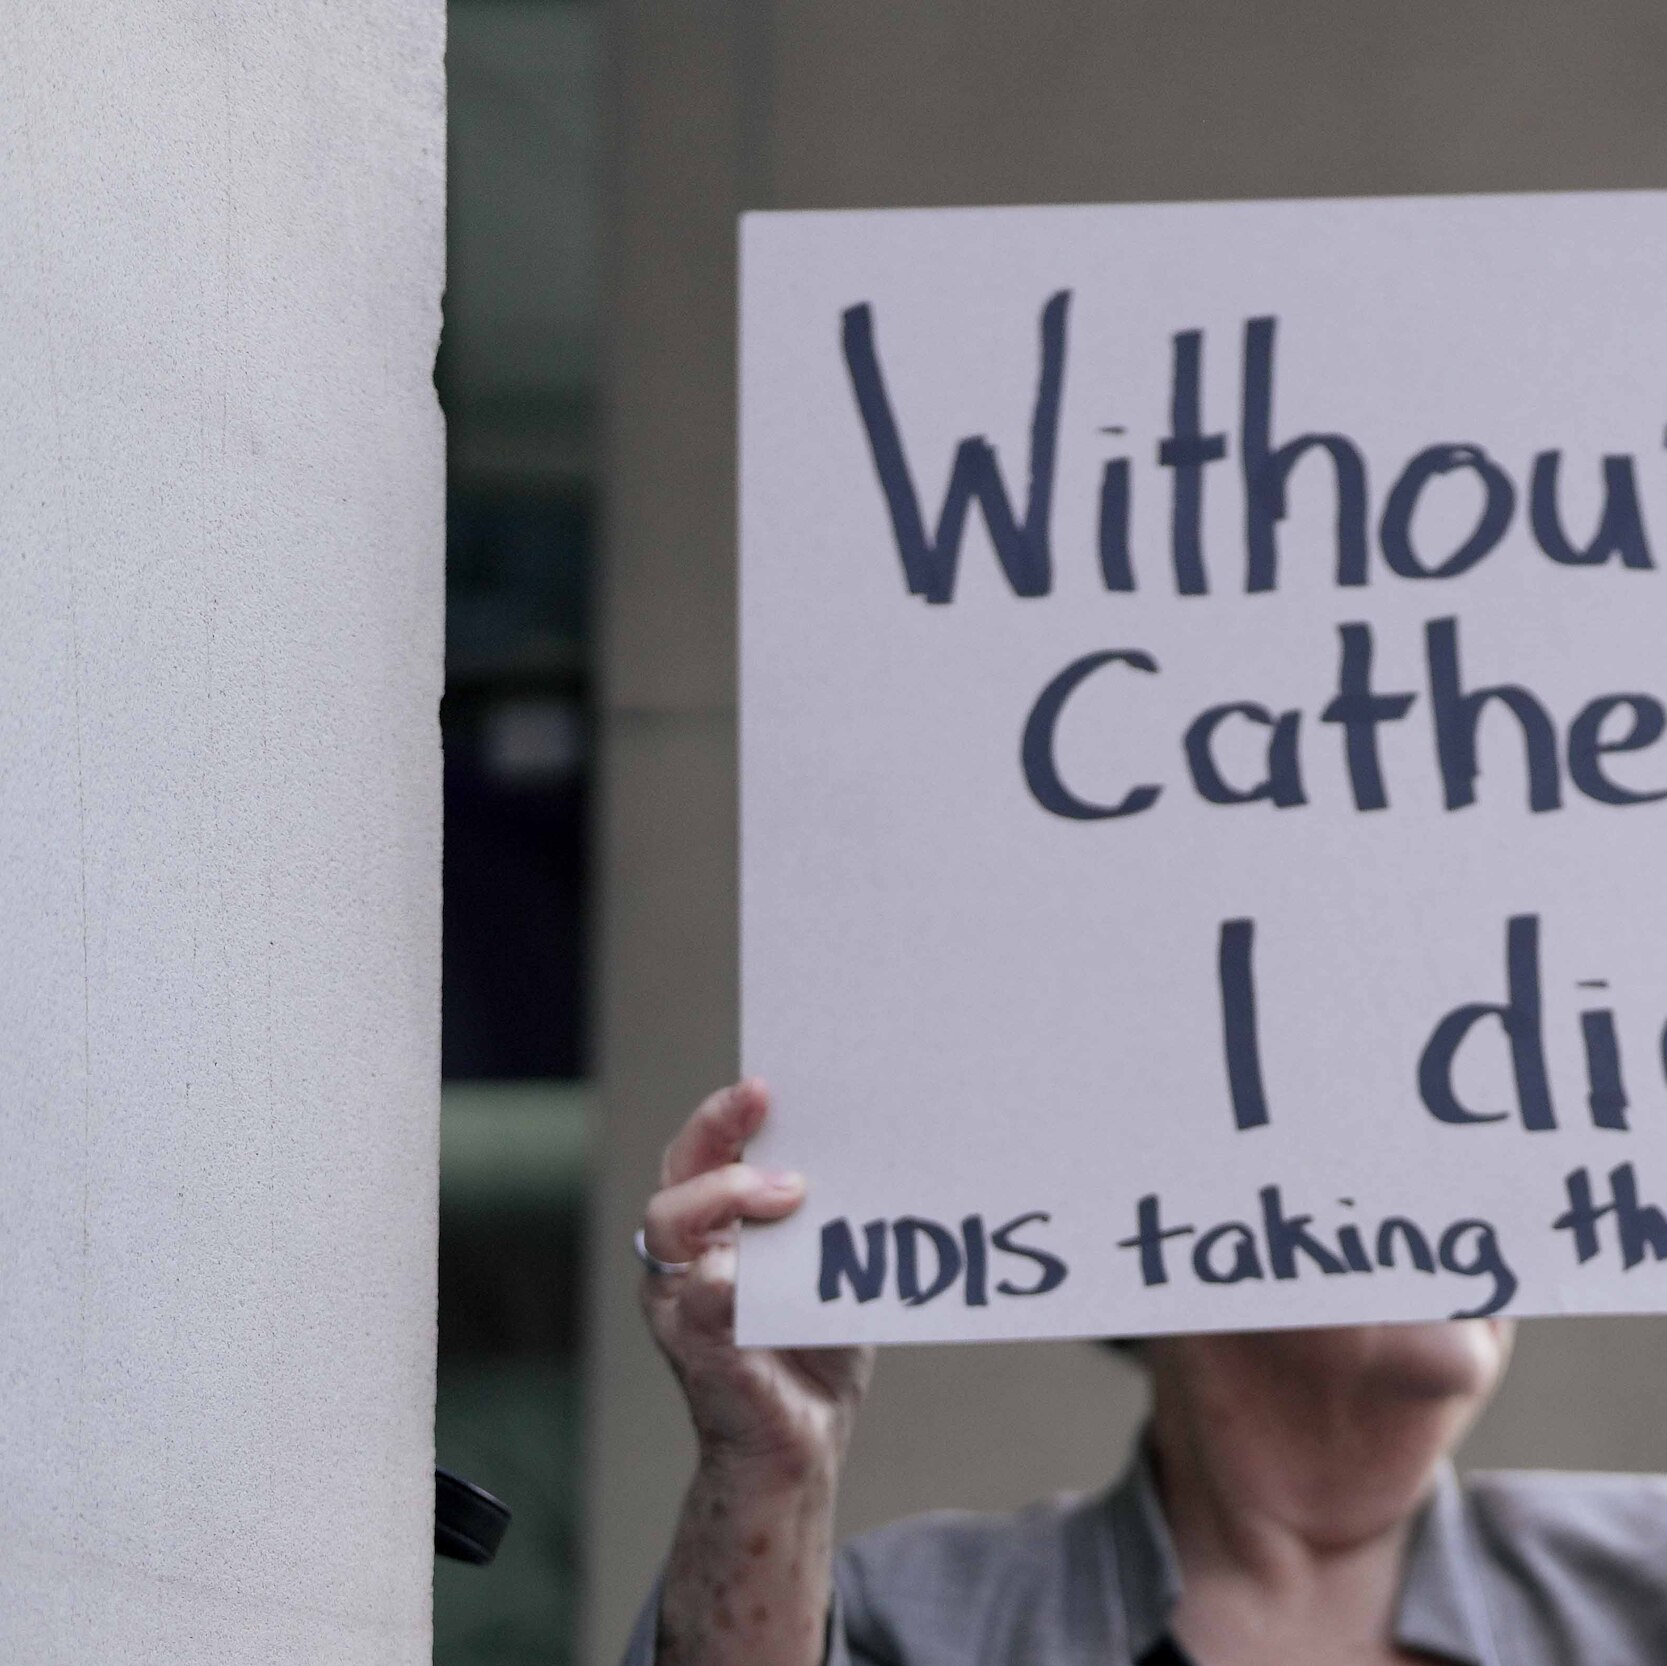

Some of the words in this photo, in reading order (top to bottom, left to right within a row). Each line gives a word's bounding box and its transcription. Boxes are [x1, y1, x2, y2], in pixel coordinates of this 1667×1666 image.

[1216, 916, 1270, 1132] I
[817, 1212, 1068, 1308] NDIS
[1117, 1184, 1515, 1320] taking
